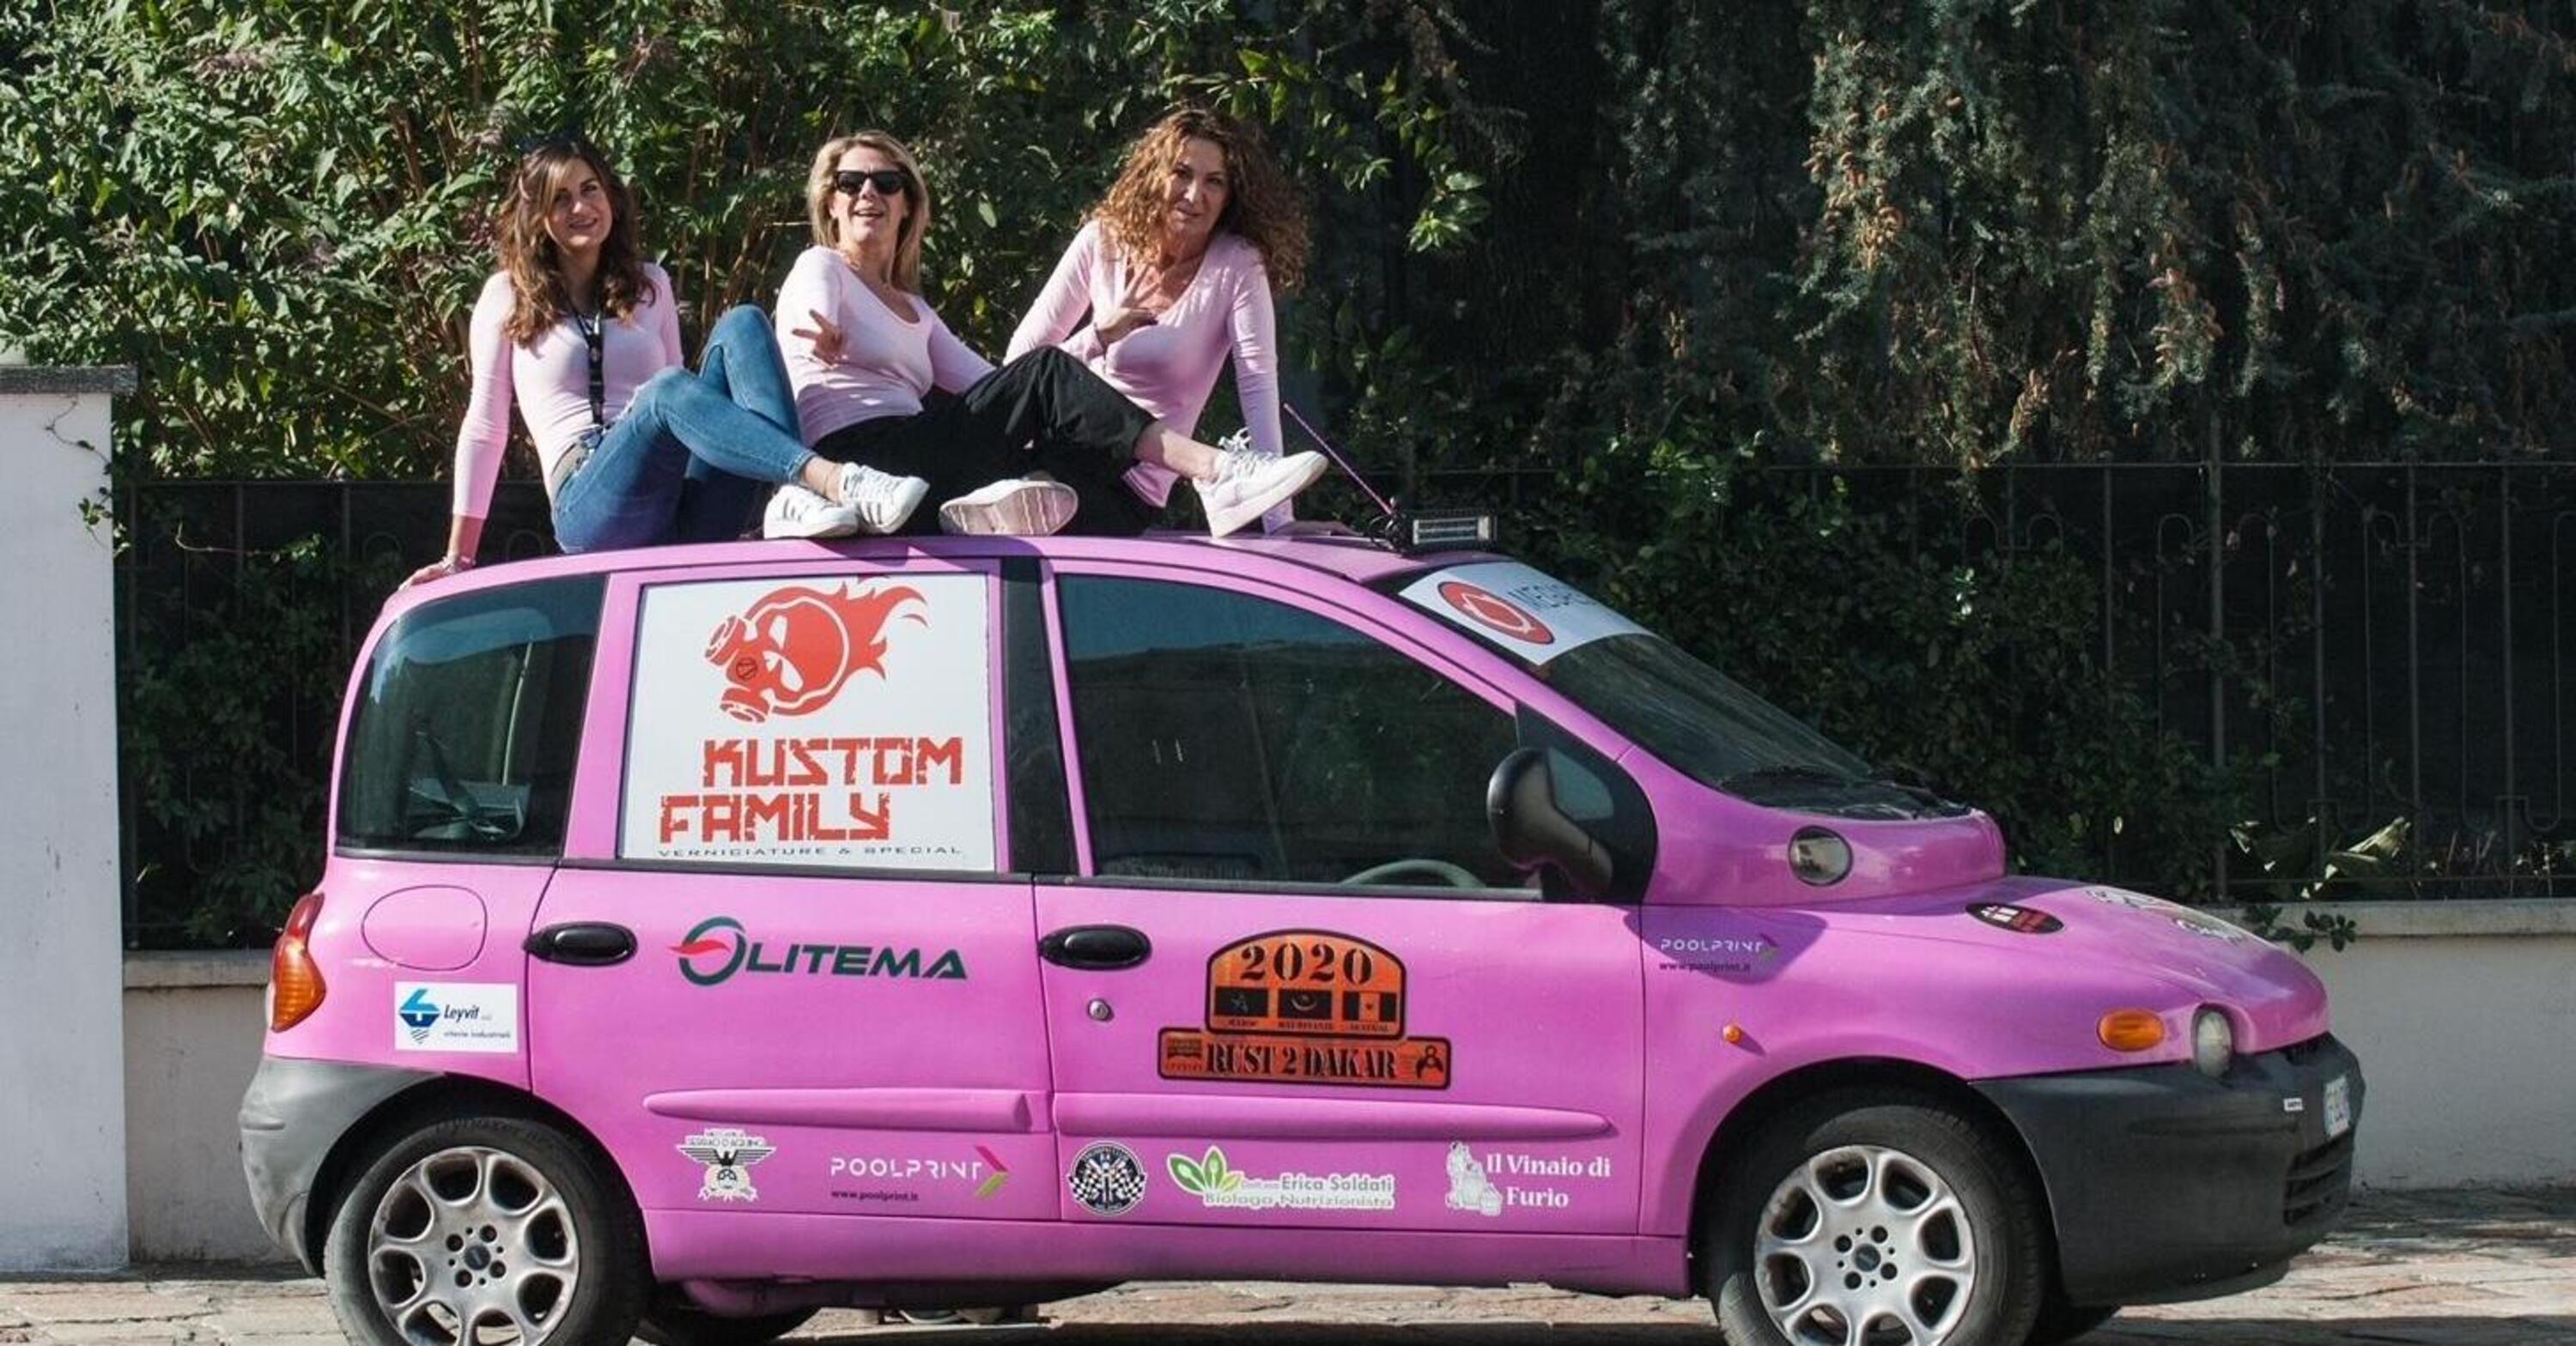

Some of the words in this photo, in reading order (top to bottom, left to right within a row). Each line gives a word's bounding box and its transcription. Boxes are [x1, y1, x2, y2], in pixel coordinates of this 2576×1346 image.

[702, 737, 963, 787] KUSTOM
[659, 793, 890, 843] FAMILY
[659, 847, 823, 857] VERNICIATURE
[1661, 938, 1764, 952] POOLPRINT
[1241, 942, 1372, 985] 2020
[444, 1003, 480, 1022] Leyvit
[1207, 1043, 1276, 1073] RUST
[1282, 1046, 1297, 1073] 2
[1303, 1046, 1396, 1078] DAKAR
[830, 1157, 982, 1180] POOLPRINT
[1486, 1153, 1502, 1173] Il
[1506, 1154, 1583, 1175] Vinaio
[1588, 1155, 1612, 1177] di
[1281, 1175, 1324, 1191] Erica
[1331, 1175, 1393, 1191] Soldati
[830, 1188, 919, 1202] www.poolprint.it
[1506, 1186, 1569, 1207] Furio
